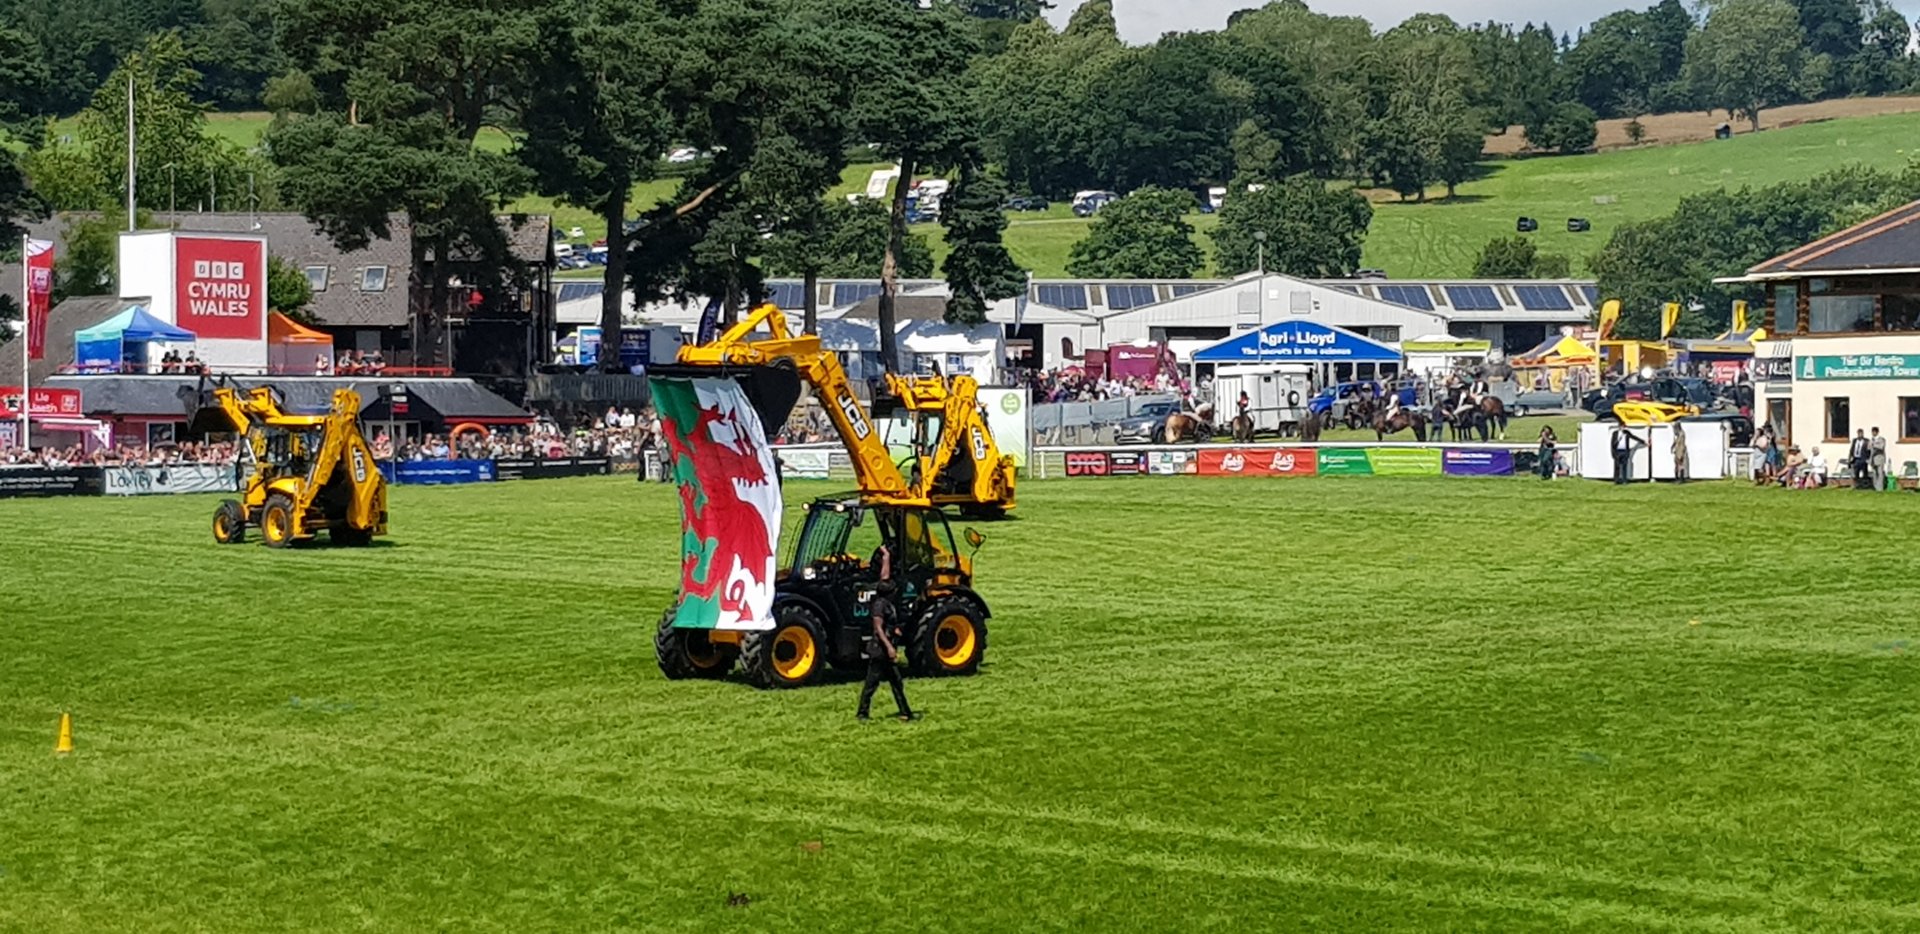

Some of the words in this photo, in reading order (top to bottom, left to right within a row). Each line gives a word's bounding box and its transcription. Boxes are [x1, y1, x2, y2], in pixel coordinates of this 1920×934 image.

[196, 262, 243, 278] BBC
[188, 281, 250, 299] CYMRU
[190, 299, 249, 317] WALES
[838, 393, 870, 440] JCB
[972, 427, 985, 459] JCB
[352, 446, 365, 481] JCB
